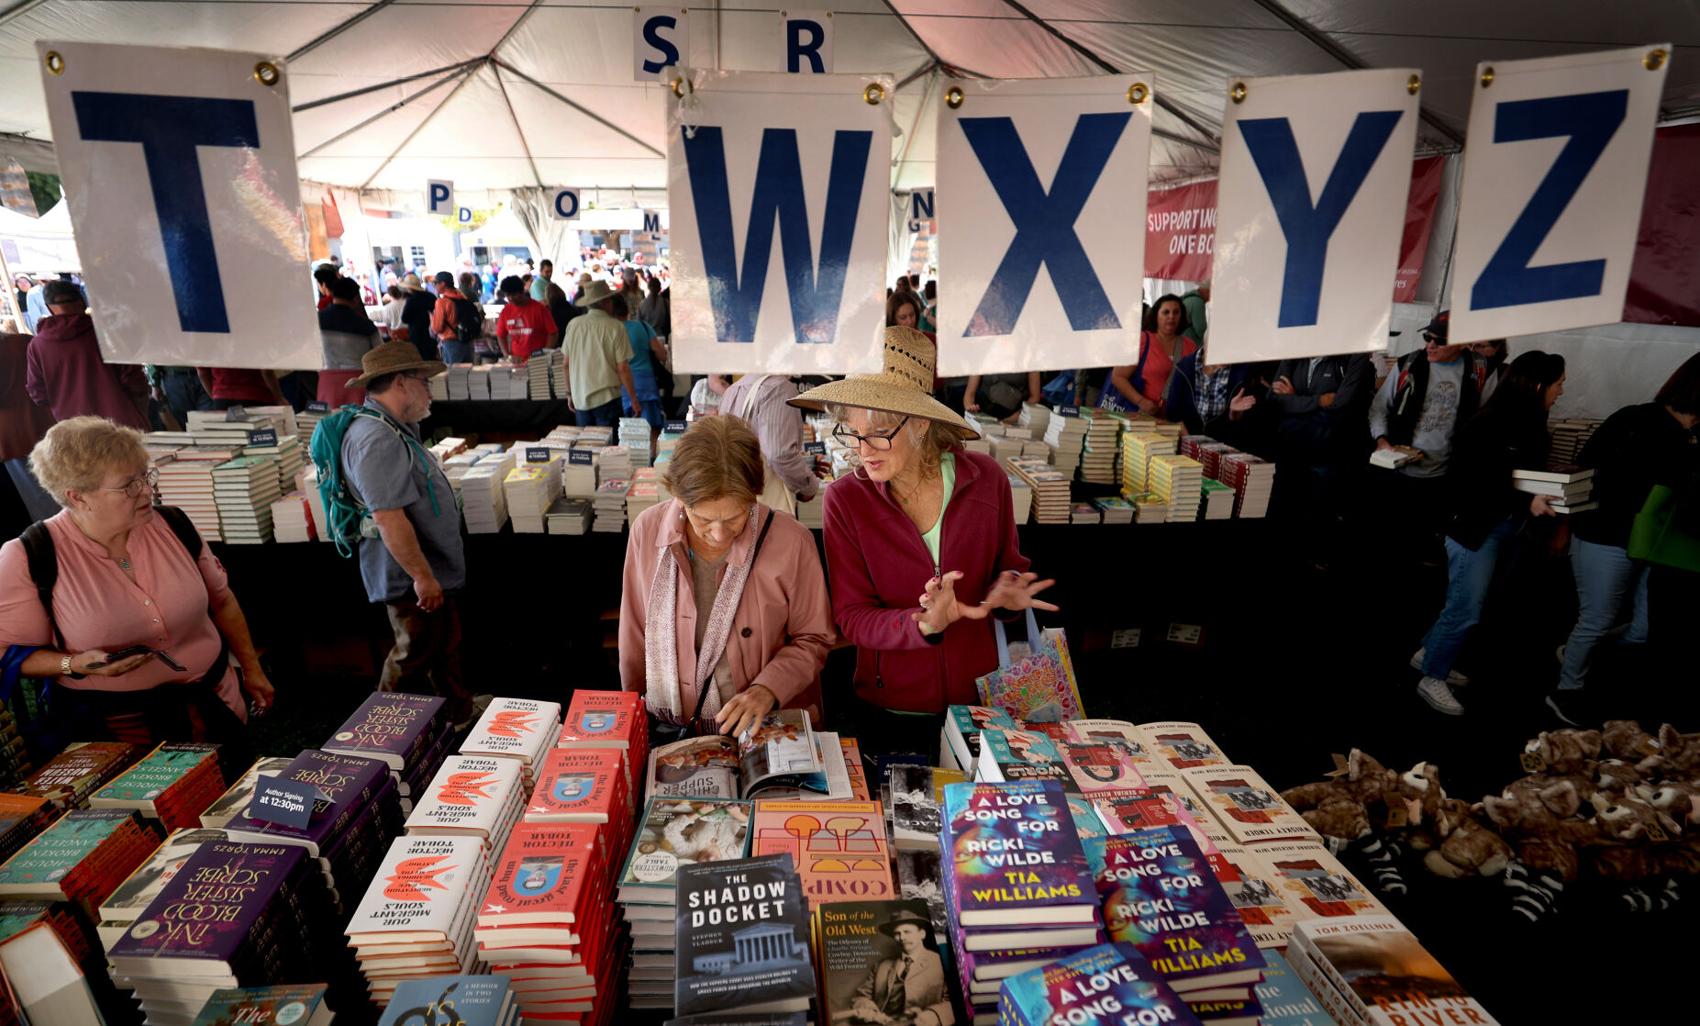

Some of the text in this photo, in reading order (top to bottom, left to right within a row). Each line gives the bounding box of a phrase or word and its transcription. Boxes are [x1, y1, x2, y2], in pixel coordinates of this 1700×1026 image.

[642, 15, 680, 74] S
[786, 19, 826, 74] R
[430, 183, 450, 211] P
[555, 190, 579, 217] O
[913, 191, 934, 218] N
[1470, 89, 1629, 311] Z
[71, 91, 260, 333] T
[460, 207, 472, 222] D
[1237, 111, 1404, 328] Y
[643, 213, 660, 232] M
[957, 112, 1133, 337] X
[681, 125, 873, 344] W
[1169, 236, 1196, 255] ONE
[354, 724, 408, 735] BLOOD
[39, 767, 92, 776] MUSEUM
[343, 759, 370, 767] EMMA
[1006, 763, 1066, 778] WORLD
[663, 776, 714, 795] SUPPER
[259, 795, 269, 804] at
[270, 796, 305, 812] 12:30pm
[264, 787, 304, 803] Author Signing
[978, 794, 1048, 807] A LOVE
[964, 808, 1022, 821] SONG
[1017, 820, 1060, 833] FOR
[1244, 826, 1312, 837] WHISKEY TENDER
[253, 848, 286, 856] EMMA
[522, 840, 575, 848] HÉCTOR
[966, 838, 1025, 852] RICKI
[31, 849, 81, 857] BROKEN
[985, 851, 1056, 867] WILDE
[1114, 844, 1183, 865] A LOVE
[567, 859, 578, 873] the
[1104, 863, 1162, 882] SONG
[557, 876, 574, 895] last
[725, 873, 748, 885] THE
[1004, 871, 1042, 885] TIA
[1160, 874, 1204, 892] FOR
[516, 892, 555, 906] great
[688, 881, 786, 908] SHADOW
[972, 883, 1082, 902] WILLIAMS
[162, 903, 242, 921] BLOOD
[369, 910, 431, 919] MIGRANT
[383, 902, 425, 910] SOULS
[692, 900, 785, 928] DOCKET
[1116, 898, 1175, 919] RICKI
[382, 918, 412, 926] OUR
[824, 910, 875, 922] Son of the
[1139, 911, 1211, 933] WILDE
[825, 924, 878, 937] Old West
[1315, 922, 1395, 935] TOM ZOELLNER
[1163, 936, 1204, 953] TIA
[1059, 964, 1139, 1006] A LOVE
[1256, 984, 1281, 998] he
[1373, 991, 1470, 1012] RIM TO
[233, 1006, 272, 1024] The
[1052, 995, 1123, 1026] SONG
[1122, 1004, 1177, 1026] FOR
[1387, 1006, 1489, 1026] RIVER
